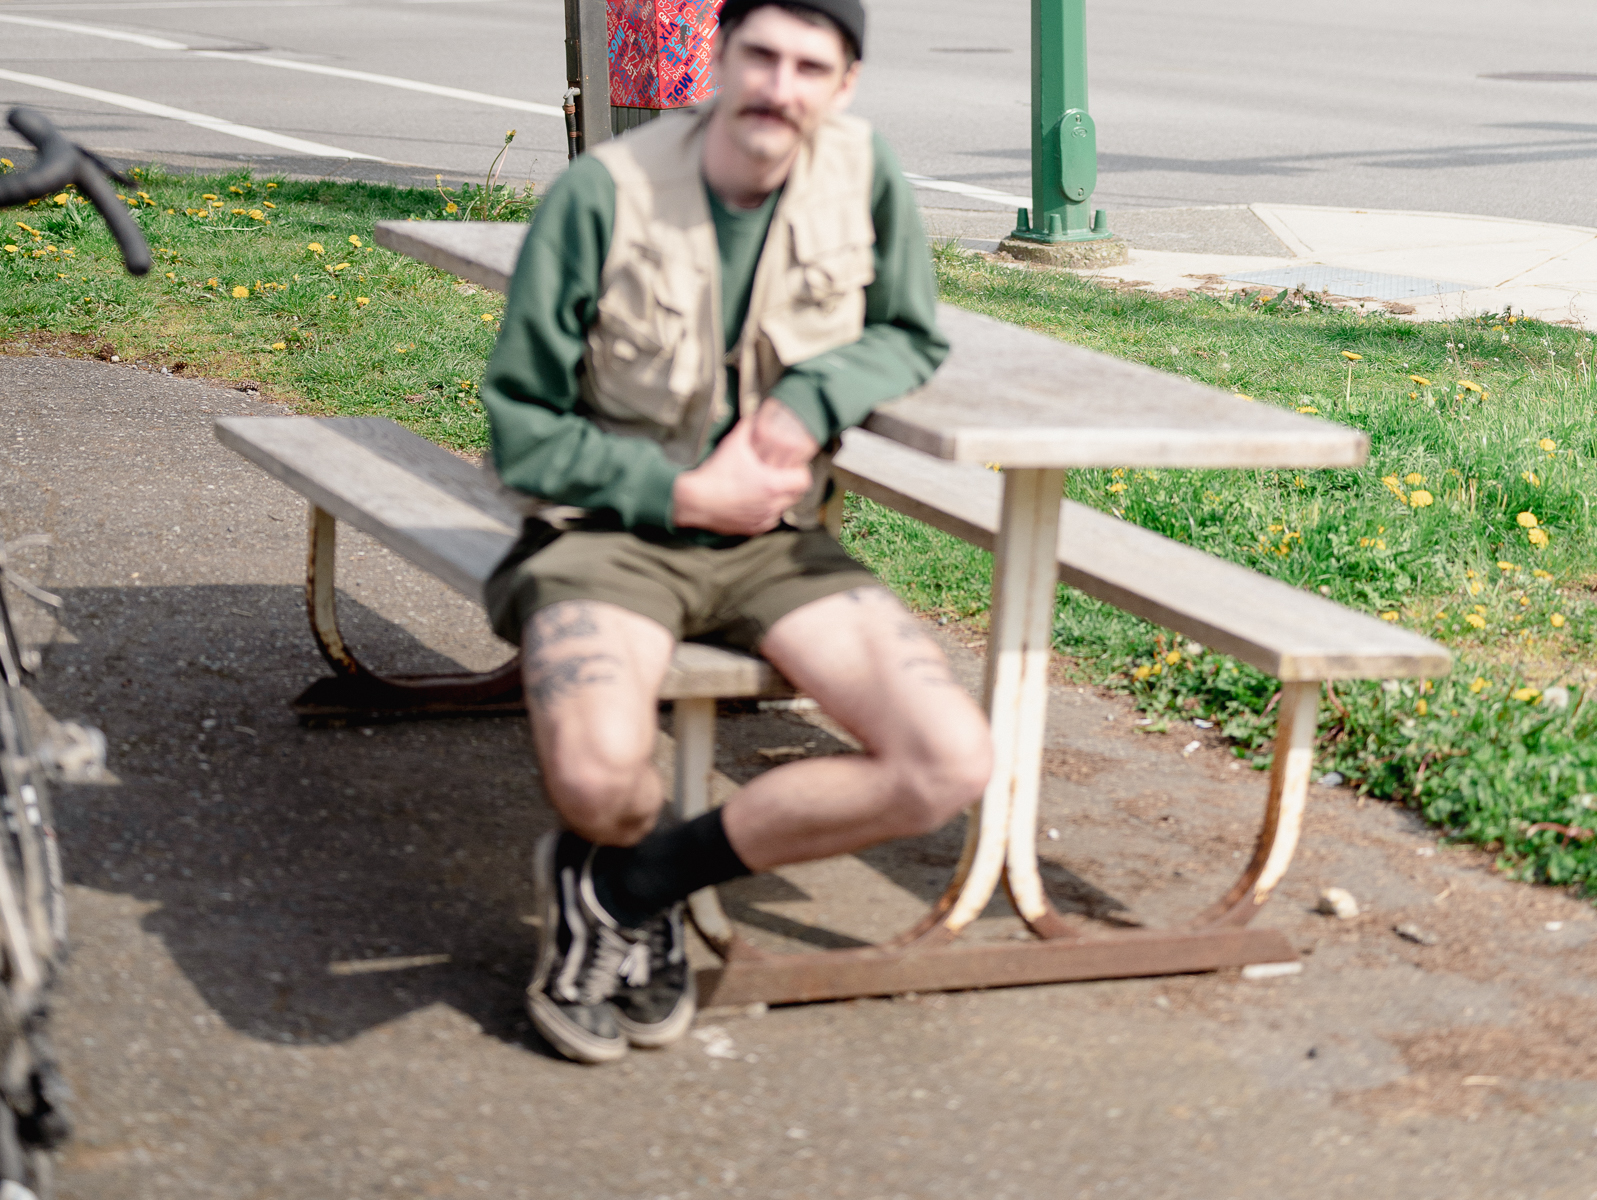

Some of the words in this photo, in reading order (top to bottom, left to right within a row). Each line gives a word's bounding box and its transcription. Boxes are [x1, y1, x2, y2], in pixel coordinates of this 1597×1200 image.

[608, 24, 626, 63] M6S
[659, 21, 680, 44] V1X
[659, 44, 682, 67] P8T
[668, 36, 690, 60] S4N
[696, 48, 712, 64] P8T
[660, 58, 676, 77] B2Z
[688, 57, 724, 100] H1X
[650, 77, 660, 98] N5P
[666, 72, 694, 102] M9L
[686, 82, 698, 98] N5P
